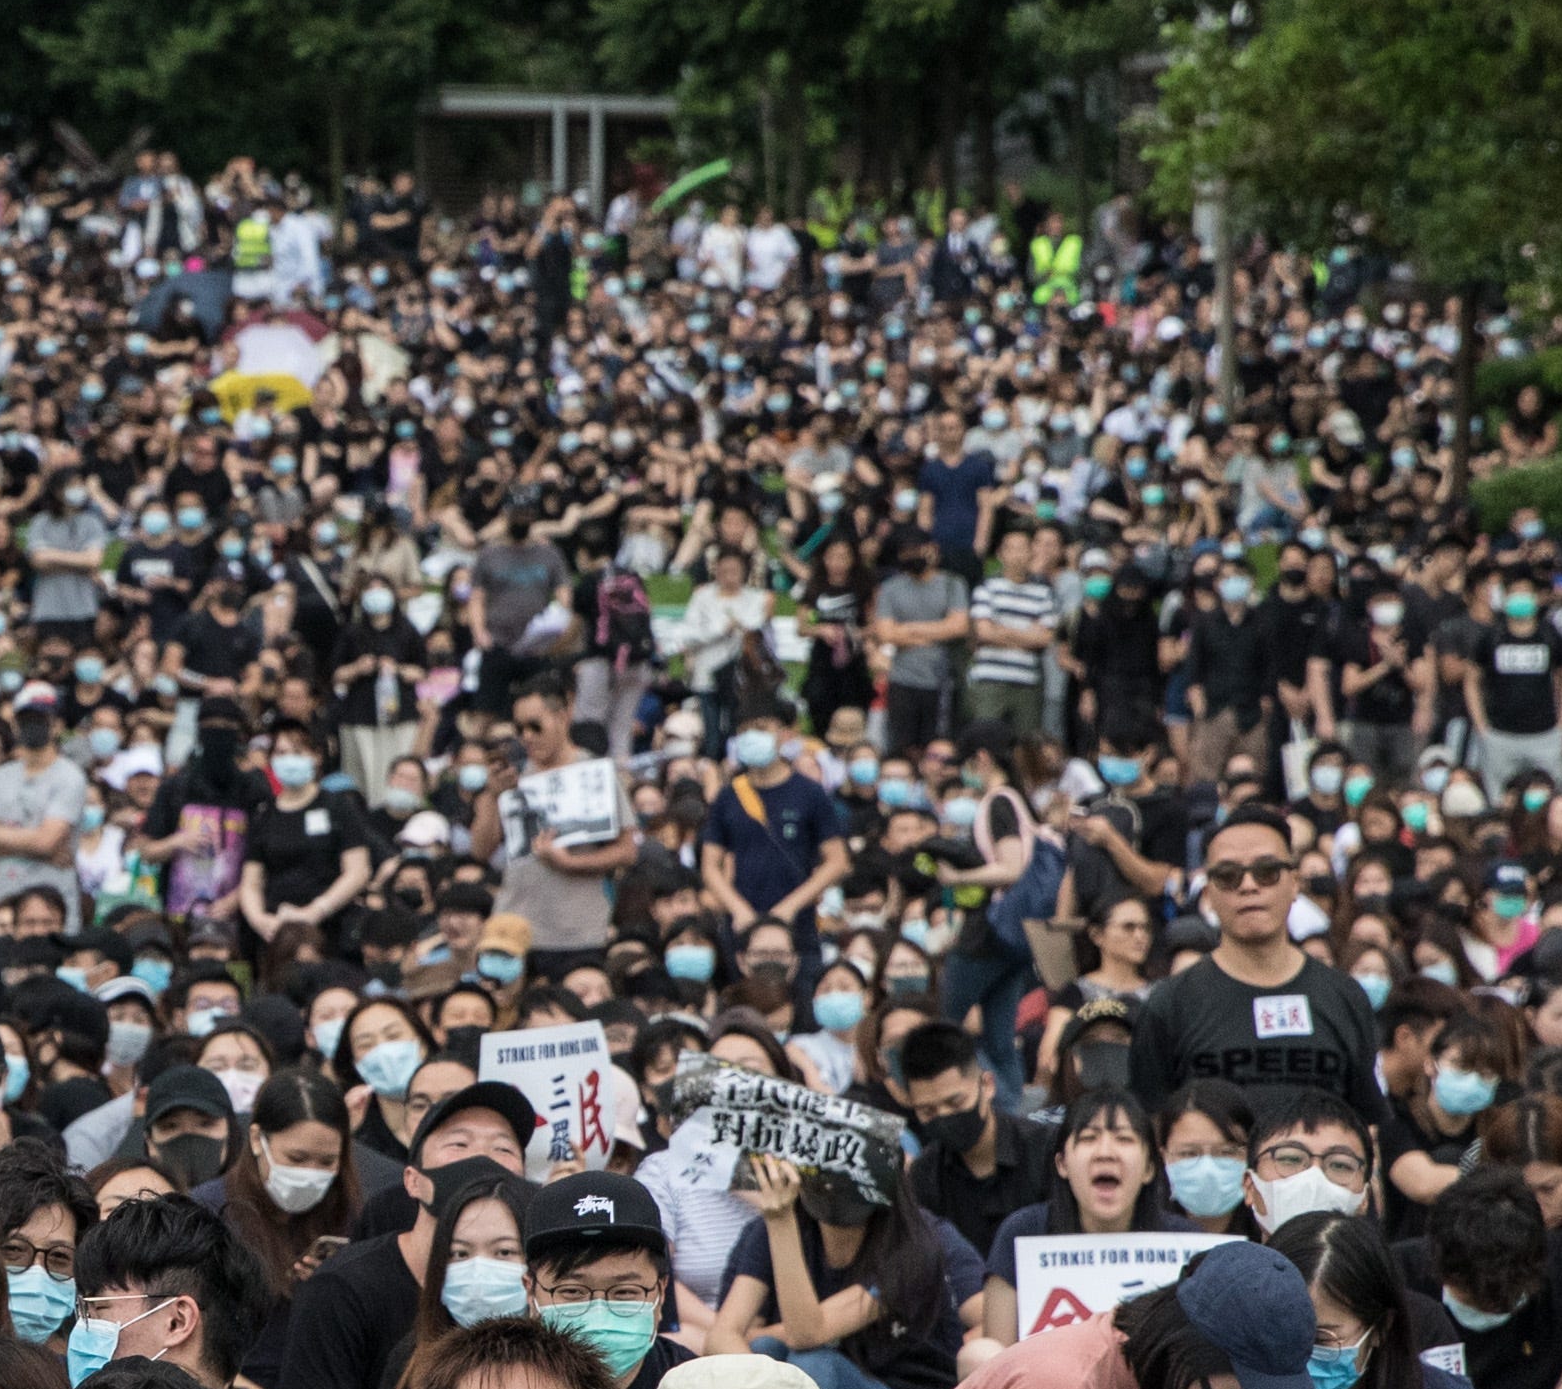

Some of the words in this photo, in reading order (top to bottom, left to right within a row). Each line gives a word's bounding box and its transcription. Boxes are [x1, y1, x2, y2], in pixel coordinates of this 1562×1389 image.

[539, 1042, 556, 1059] FOR
[1193, 1047, 1340, 1079] SPEED
[579, 1068, 610, 1156] 民
[1100, 1248, 1129, 1264] FOR
[1134, 1248, 1177, 1264] HONG
